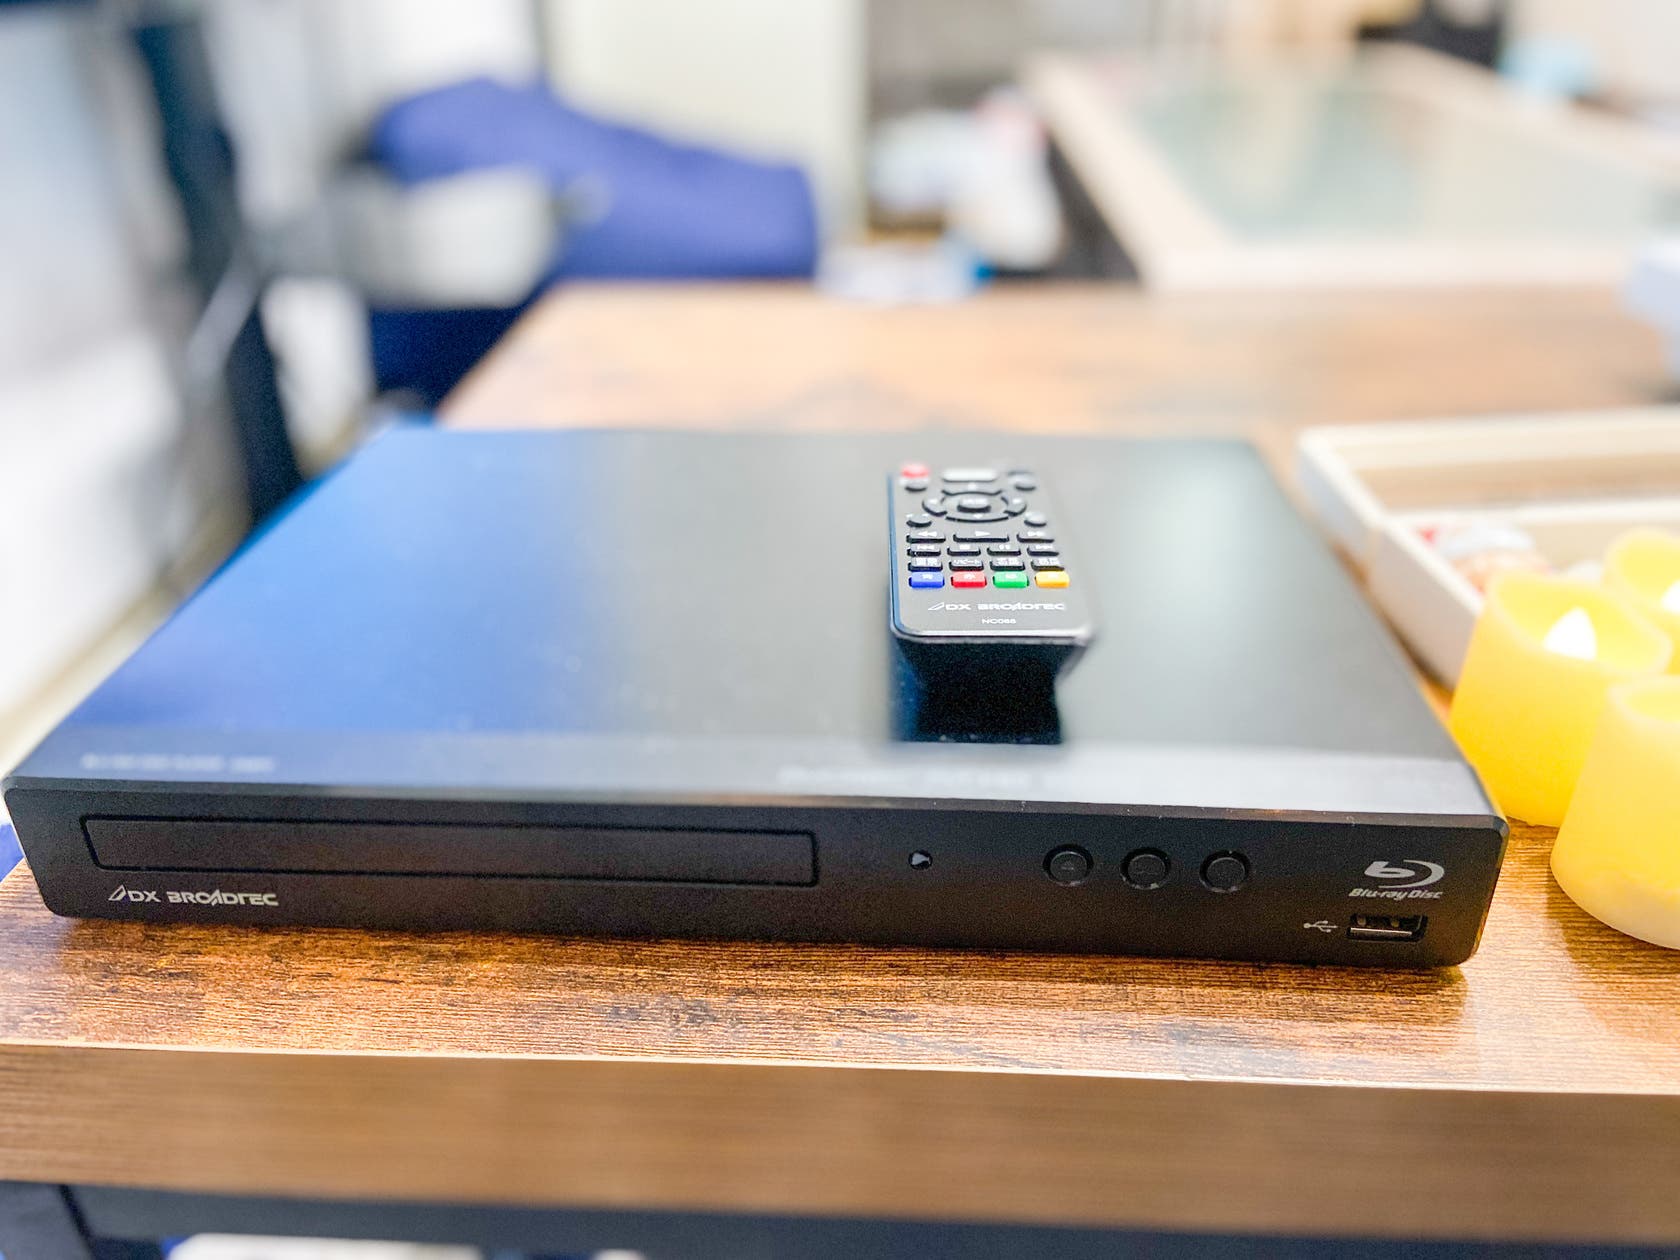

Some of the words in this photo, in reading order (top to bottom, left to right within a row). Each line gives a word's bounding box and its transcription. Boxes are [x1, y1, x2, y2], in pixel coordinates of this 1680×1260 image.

[977, 601, 1065, 611] BROADTEC
[108, 884, 162, 903] ADX
[166, 889, 279, 907] BROADTEC
[1348, 887, 1408, 901] Blu-ray
[1408, 890, 1443, 900] Disc
